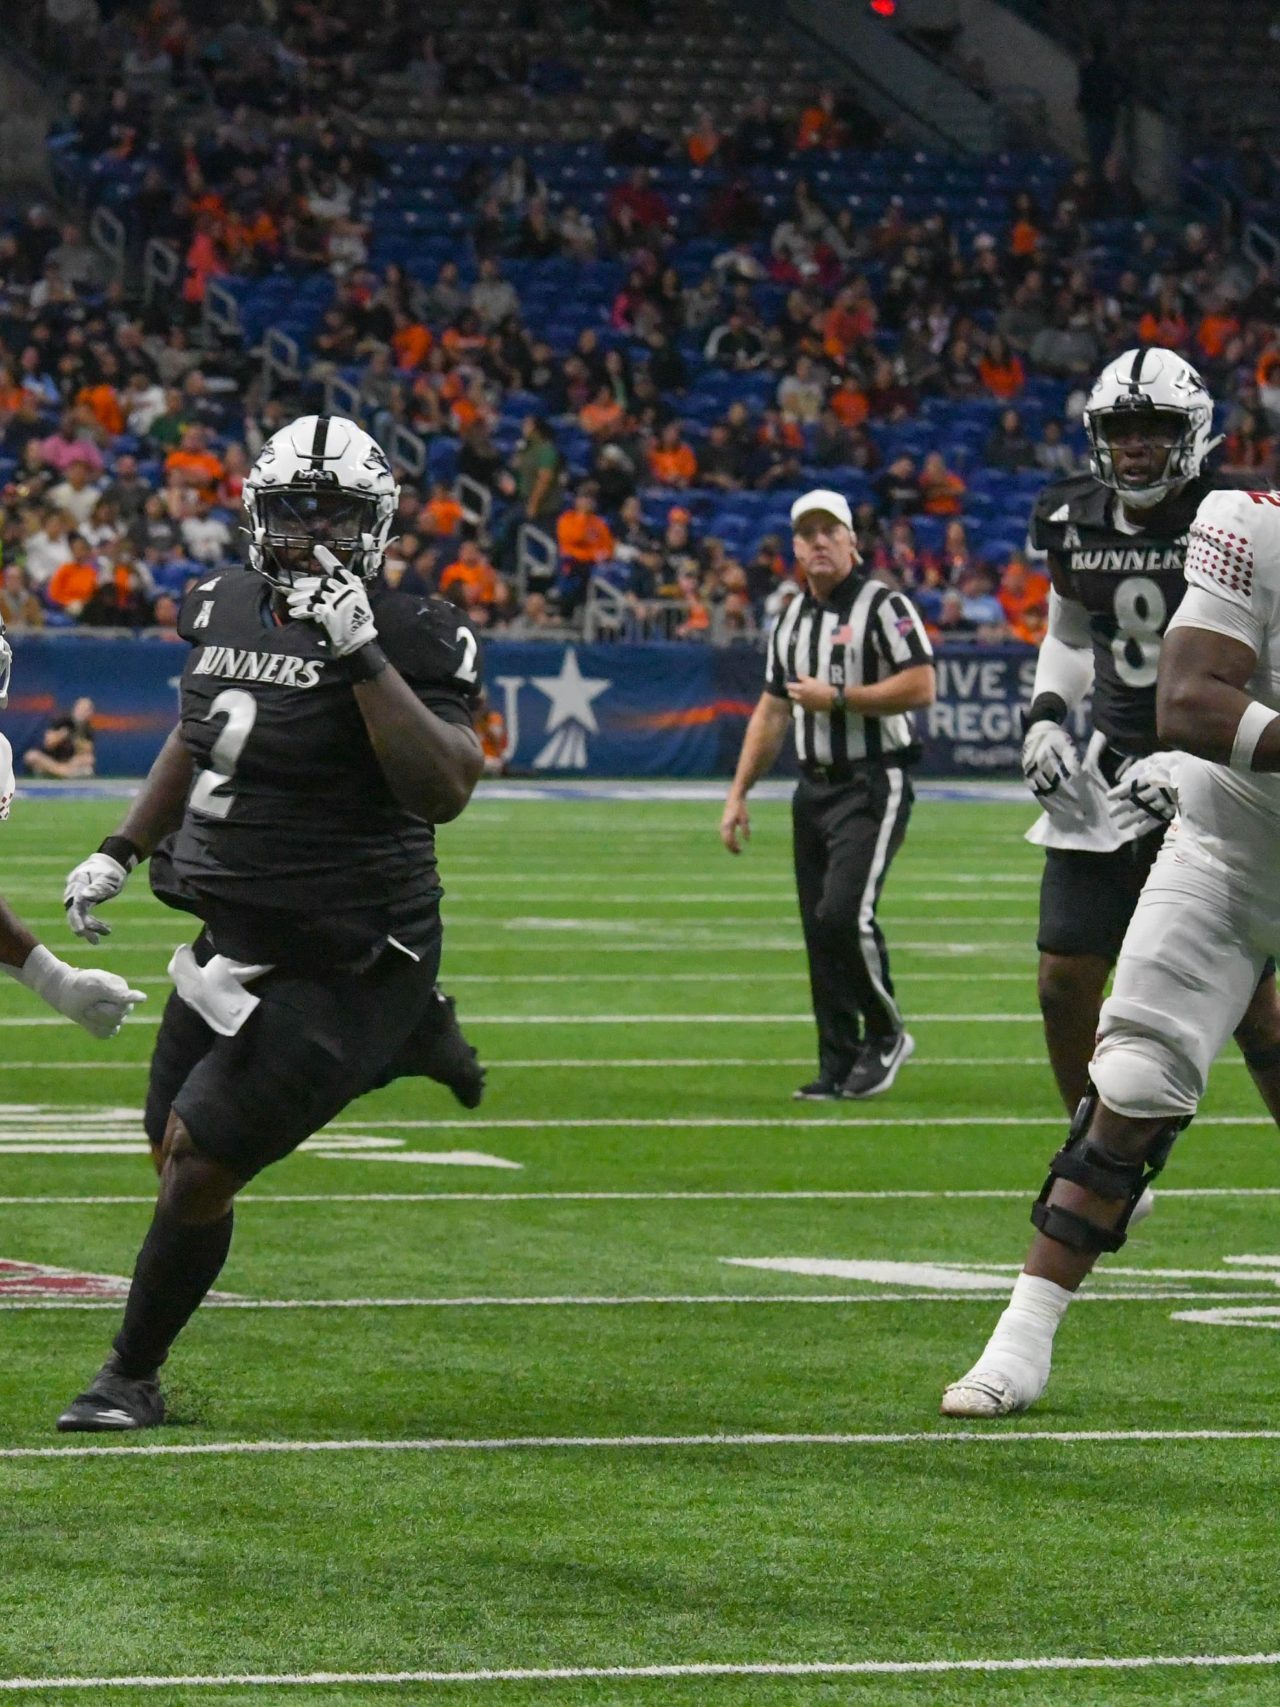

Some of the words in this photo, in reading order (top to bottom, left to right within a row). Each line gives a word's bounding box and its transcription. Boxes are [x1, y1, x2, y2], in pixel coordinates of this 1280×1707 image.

[1071, 548, 1184, 571] RUNNER
[453, 626, 478, 684] 2
[1111, 576, 1166, 688] 8
[831, 664, 844, 686] R
[188, 688, 258, 820] 2
